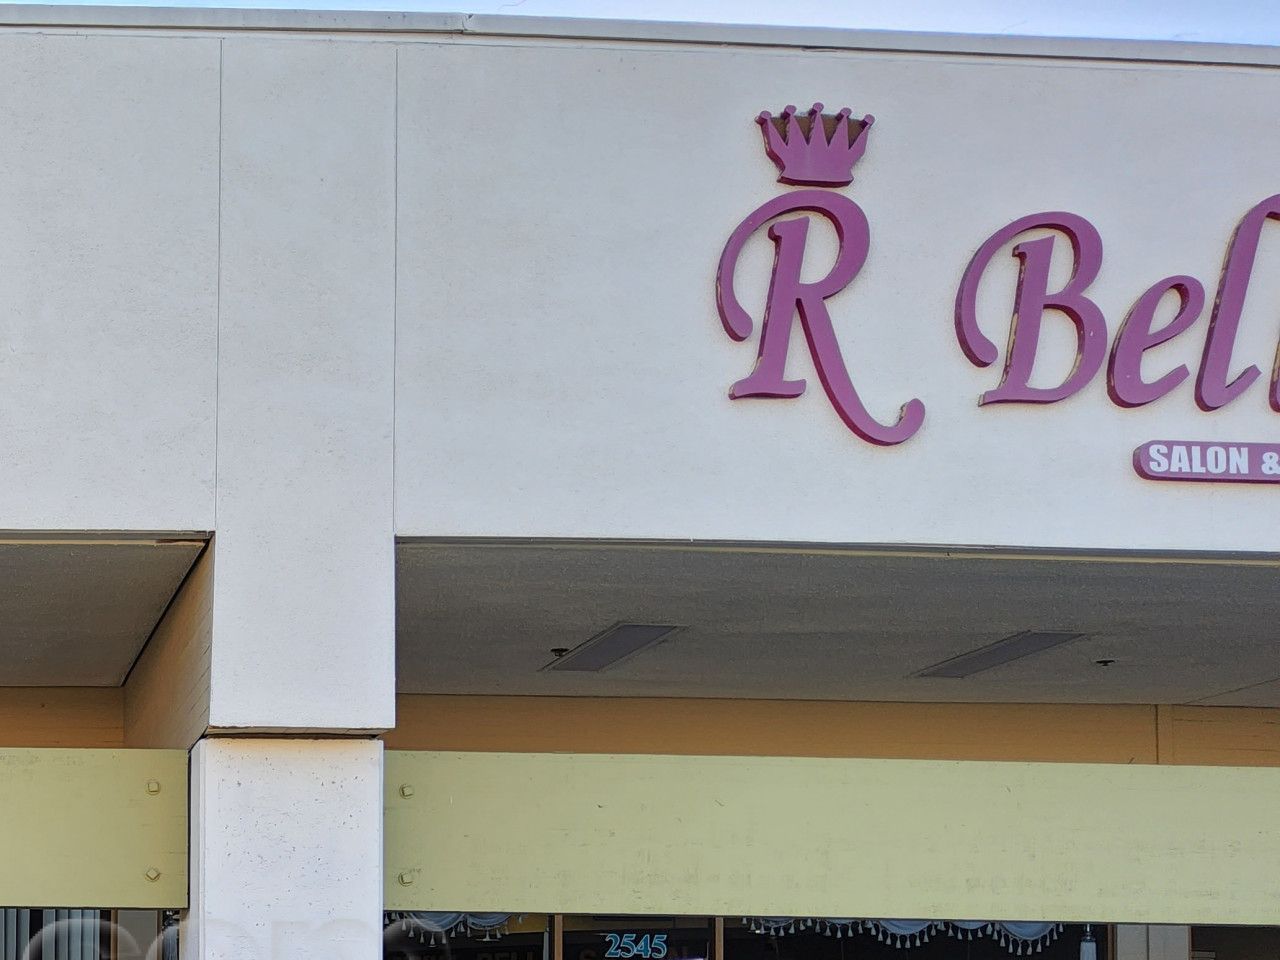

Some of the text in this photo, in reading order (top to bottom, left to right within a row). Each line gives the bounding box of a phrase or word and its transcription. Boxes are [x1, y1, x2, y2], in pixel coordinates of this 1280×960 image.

[716, 188, 1280, 446] R Bel
[1148, 444, 1280, 475] SALON &
[604, 933, 668, 959] 2545
